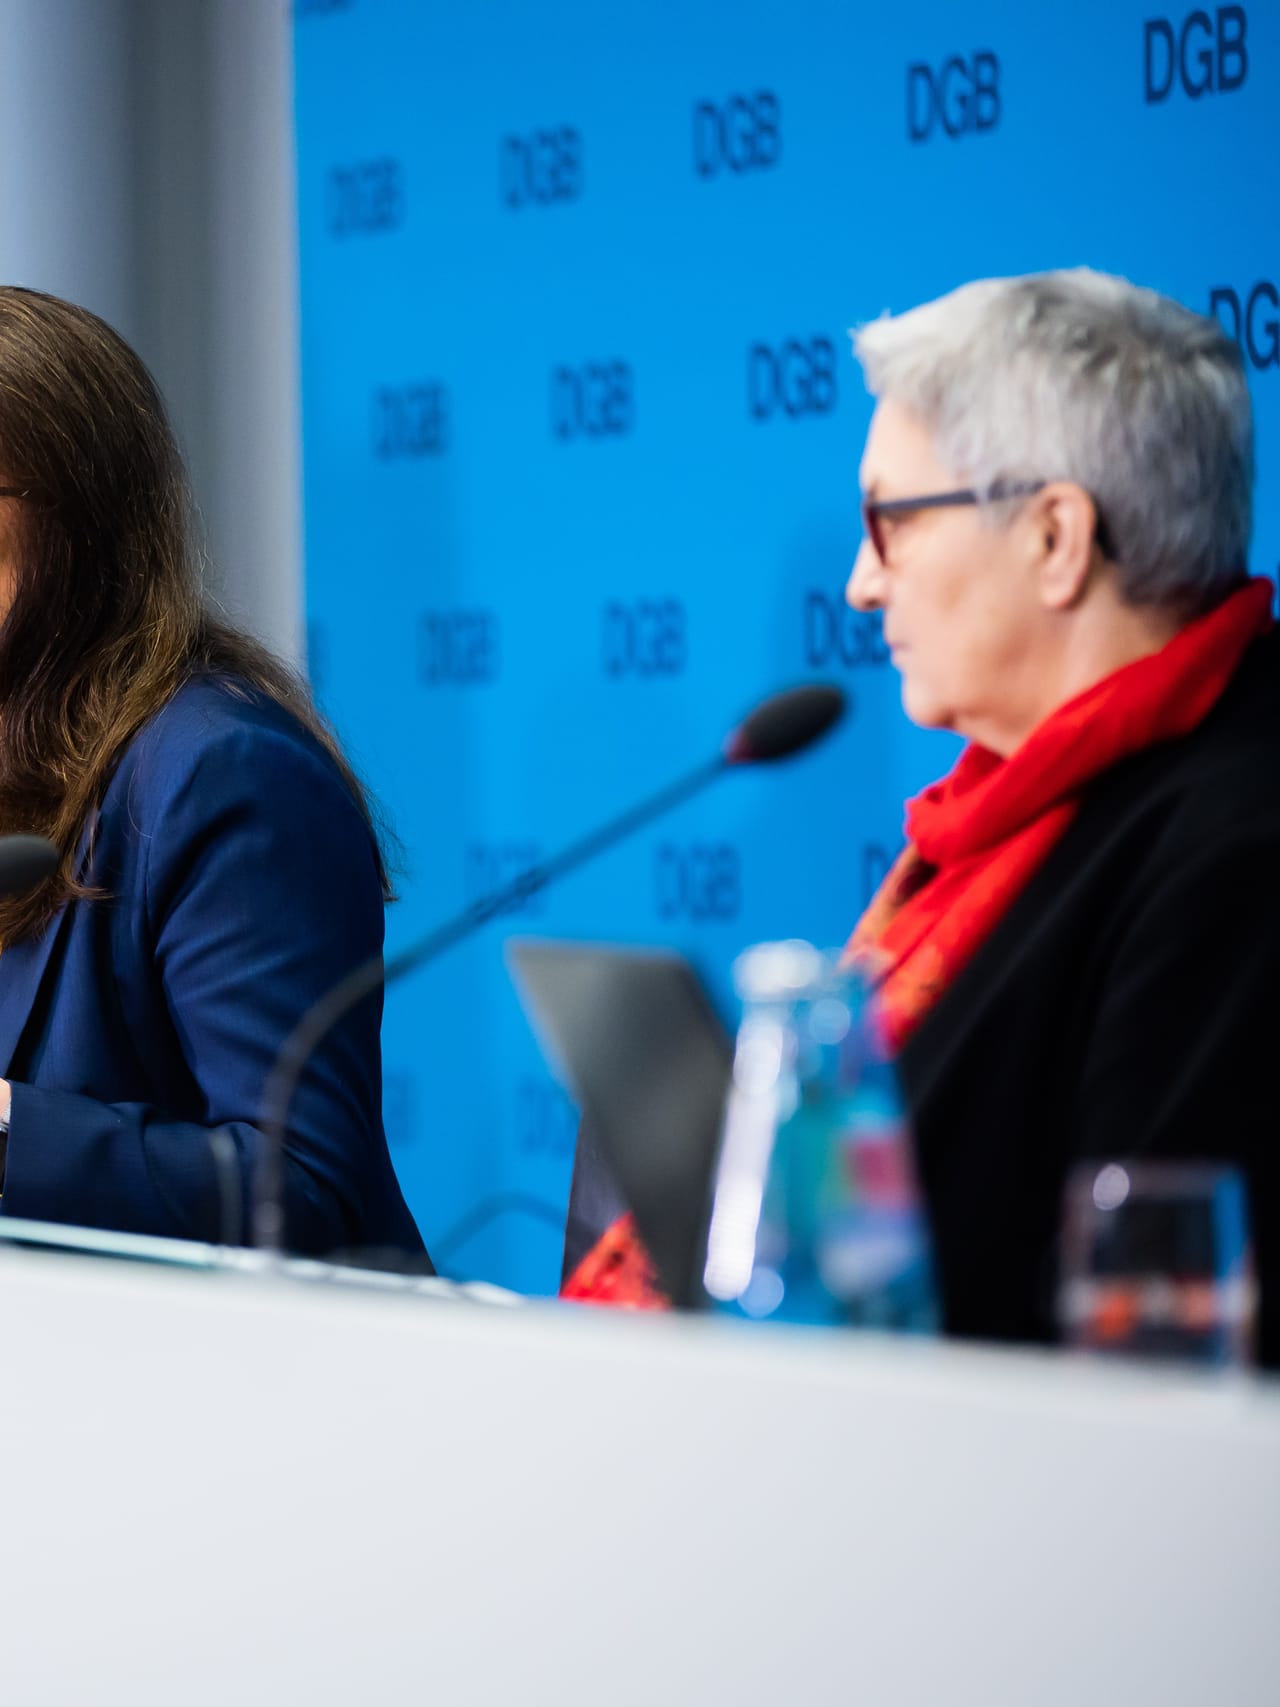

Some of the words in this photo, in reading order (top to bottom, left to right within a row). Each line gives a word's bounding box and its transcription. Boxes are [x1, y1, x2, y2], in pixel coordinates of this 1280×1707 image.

[907, 51, 1000, 143] DGB
[1143, 6, 1249, 104] DGB
[693, 90, 780, 179] DGB
[1210, 282, 1280, 370] DG
[749, 336, 837, 424] DGB
